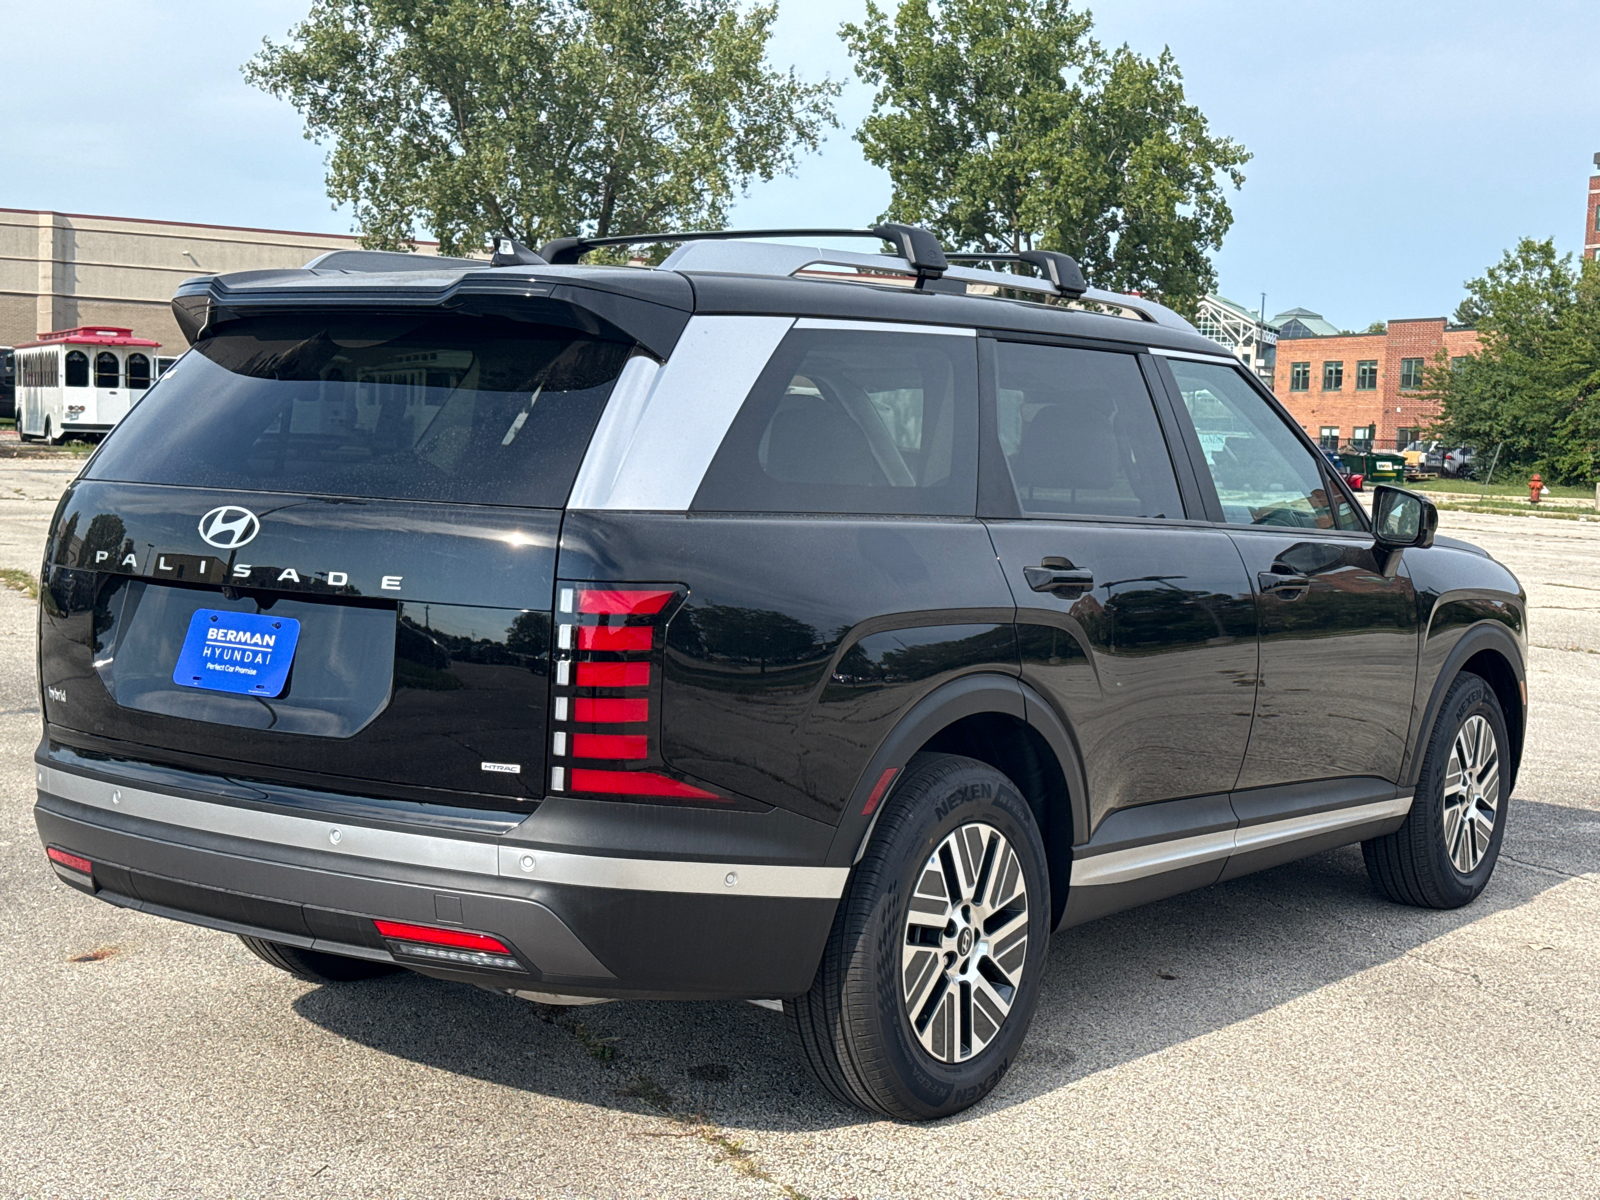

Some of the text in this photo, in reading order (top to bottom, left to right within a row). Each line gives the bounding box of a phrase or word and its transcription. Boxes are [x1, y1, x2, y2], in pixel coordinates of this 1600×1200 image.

[95, 550, 403, 590] PALISADE
[207, 628, 276, 646] BERMAN
[203, 646, 271, 665] HYUNDAI
[206, 662, 257, 675] Perfect Car Promise
[1456, 689, 1482, 721] NEXEN
[483, 764, 518, 772] HTRAC
[935, 783, 992, 822] NEXEN
